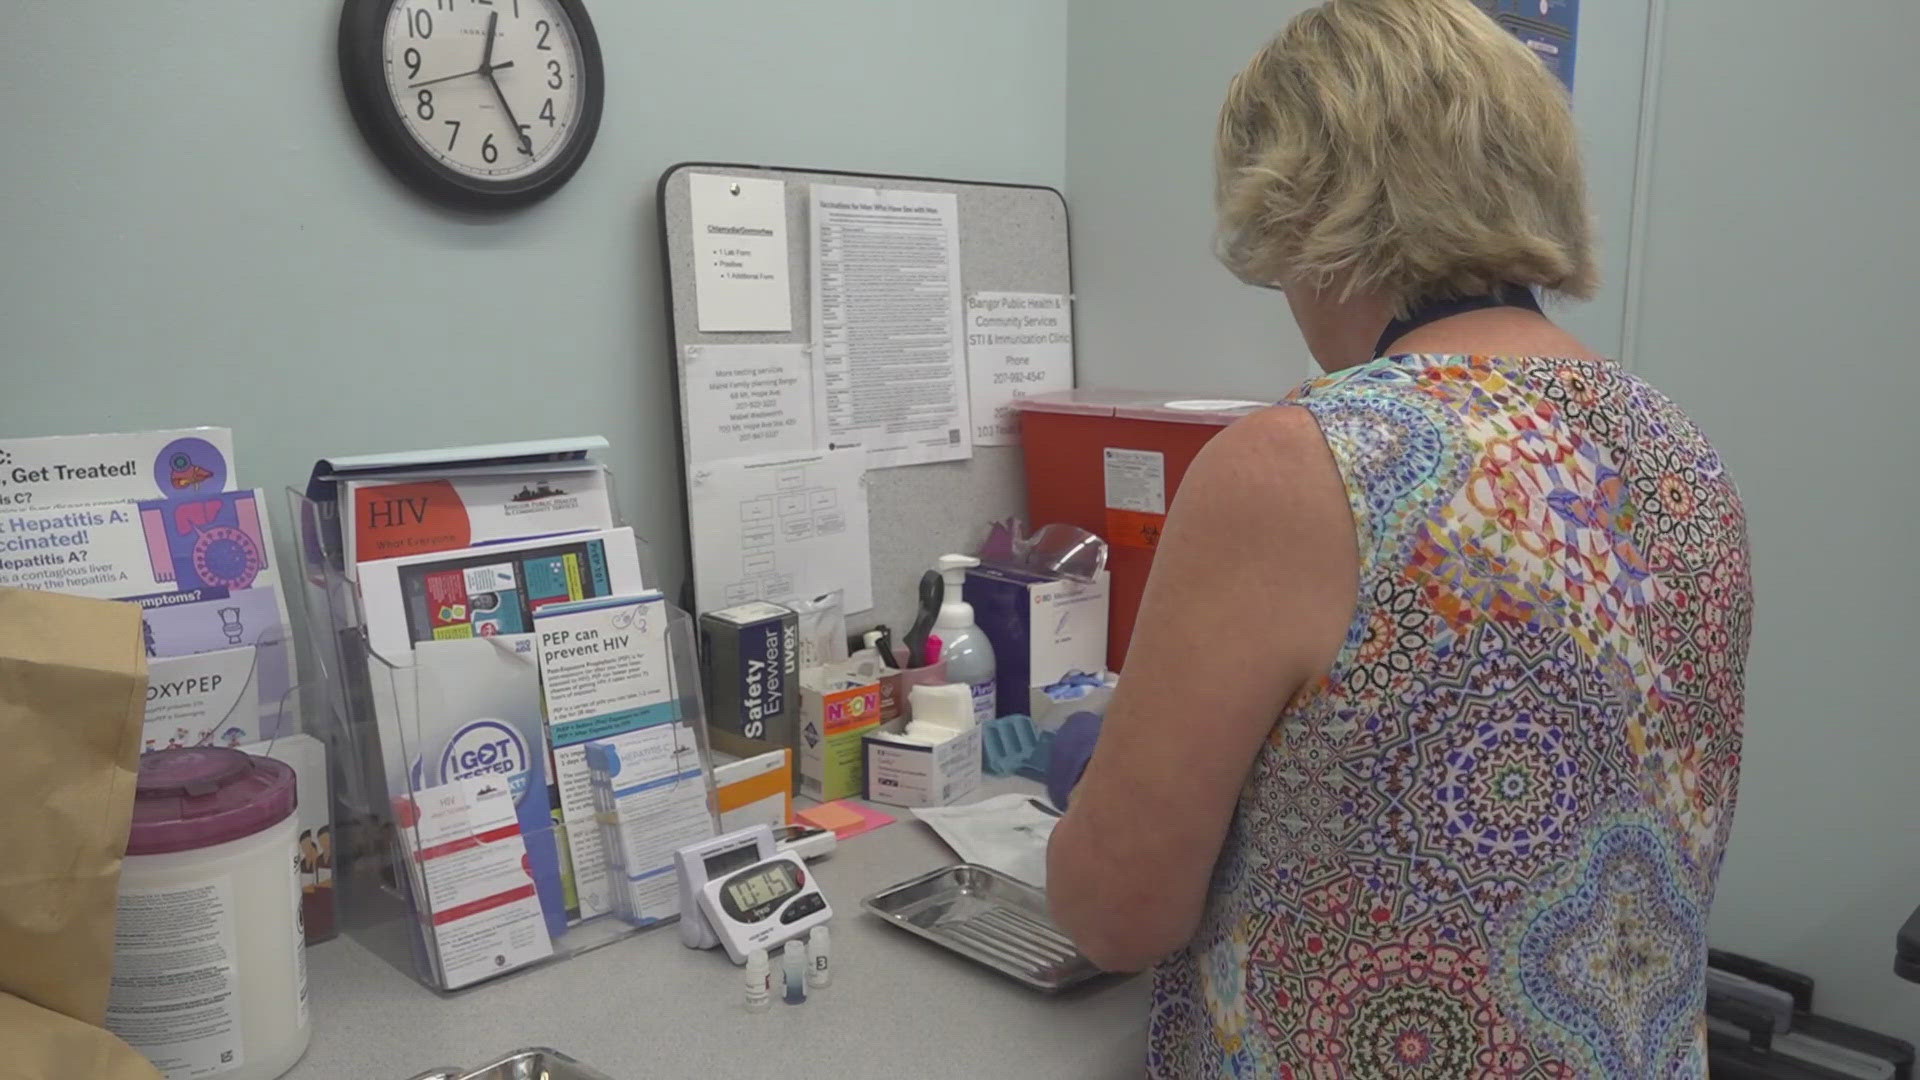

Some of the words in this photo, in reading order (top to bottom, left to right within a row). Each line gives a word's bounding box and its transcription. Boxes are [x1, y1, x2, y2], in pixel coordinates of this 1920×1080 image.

[407, 8, 433, 39] 10
[535, 20, 551, 50] 2
[404, 48, 421, 79] 9
[547, 60, 563, 90] 3
[417, 89, 434, 121] 8
[539, 98, 556, 127] 4
[444, 120, 461, 151] 7
[481, 133, 498, 164] 6
[517, 124, 532, 155] 5
[968, 297, 1000, 312] Bangor
[1002, 298, 1027, 309] Public
[1027, 299, 1052, 309] Health
[975, 315, 1022, 329] Community
[1024, 316, 1058, 327] Services
[969, 334, 986, 345] STI
[995, 333, 1048, 345] Immunization
[1049, 332, 1071, 344] Clinic
[1005, 355, 1030, 366] Phone
[11, 467, 49, 483] Get
[53, 460, 137, 480] Treated!
[14, 492, 32, 504] C?
[368, 497, 429, 528] HIV
[9, 510, 105, 533] Hepatitis
[109, 509, 129, 524] A:
[406, 533, 457, 549] Everyone
[68, 550, 88, 563] A?
[12, 574, 19, 582] a
[22, 566, 87, 580] contagious
[89, 564, 112, 573] liver
[44, 579, 64, 589] the
[66, 573, 117, 588] hepatitis
[119, 571, 128, 580] A
[542, 630, 569, 647] PEP
[575, 629, 599, 642] can
[545, 644, 599, 665] prevent
[603, 634, 630, 651] HIV
[783, 626, 795, 674] uvex
[764, 628, 783, 716] Eyewear
[744, 659, 766, 739] Safety
[460, 738, 511, 771] GOT
[816, 956, 828, 970] 3
